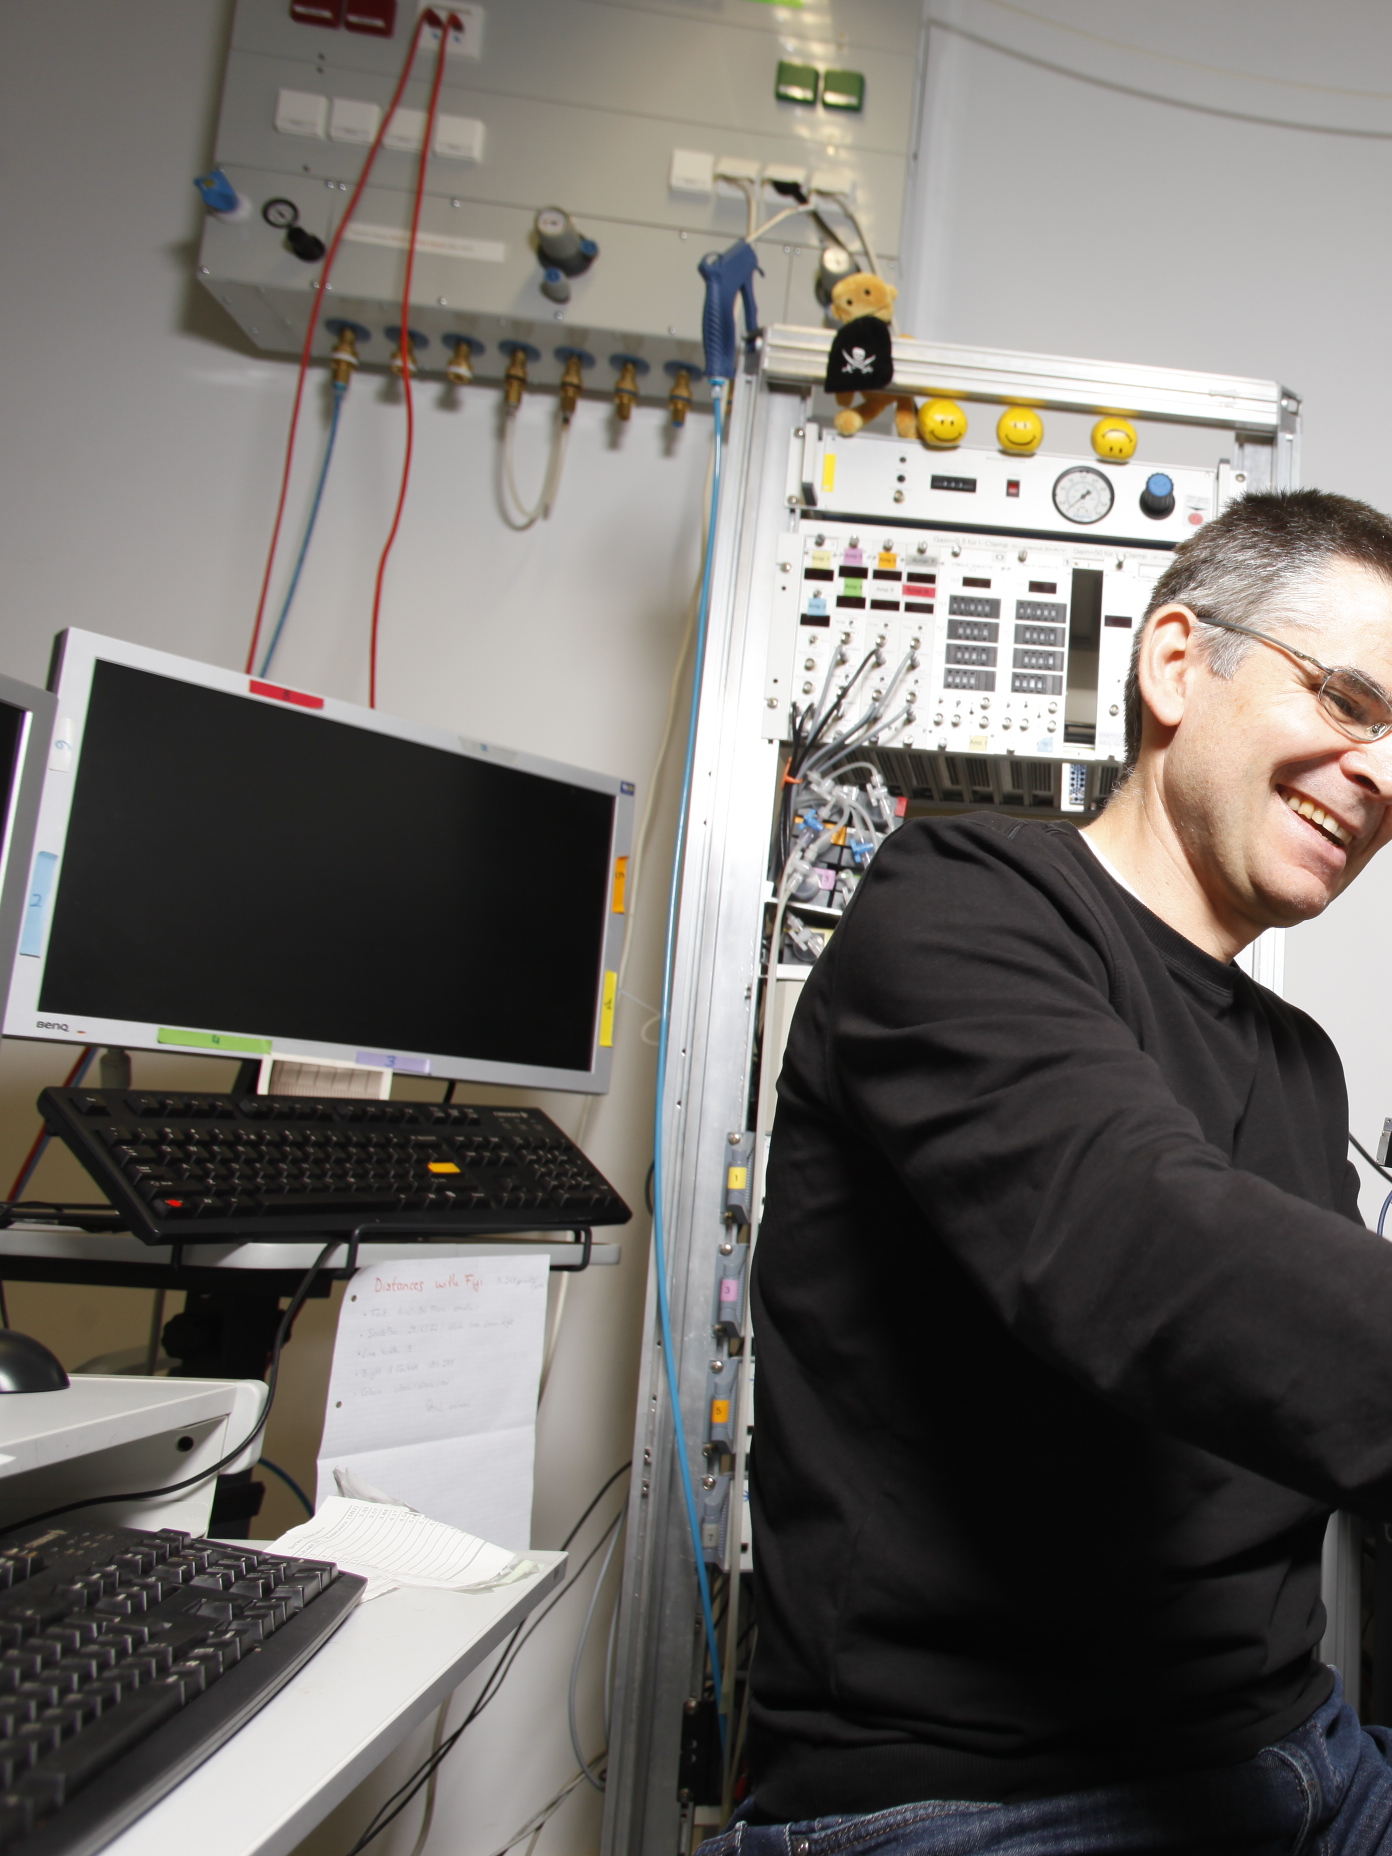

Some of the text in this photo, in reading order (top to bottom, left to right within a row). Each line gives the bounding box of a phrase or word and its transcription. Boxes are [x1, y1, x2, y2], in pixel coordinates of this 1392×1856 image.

[30, 893, 42, 908] 2
[36, 1021, 69, 1032] BenQ
[384, 1055, 396, 1067] 3
[374, 1276, 424, 1293] Distances
[435, 1273, 459, 1289] with
